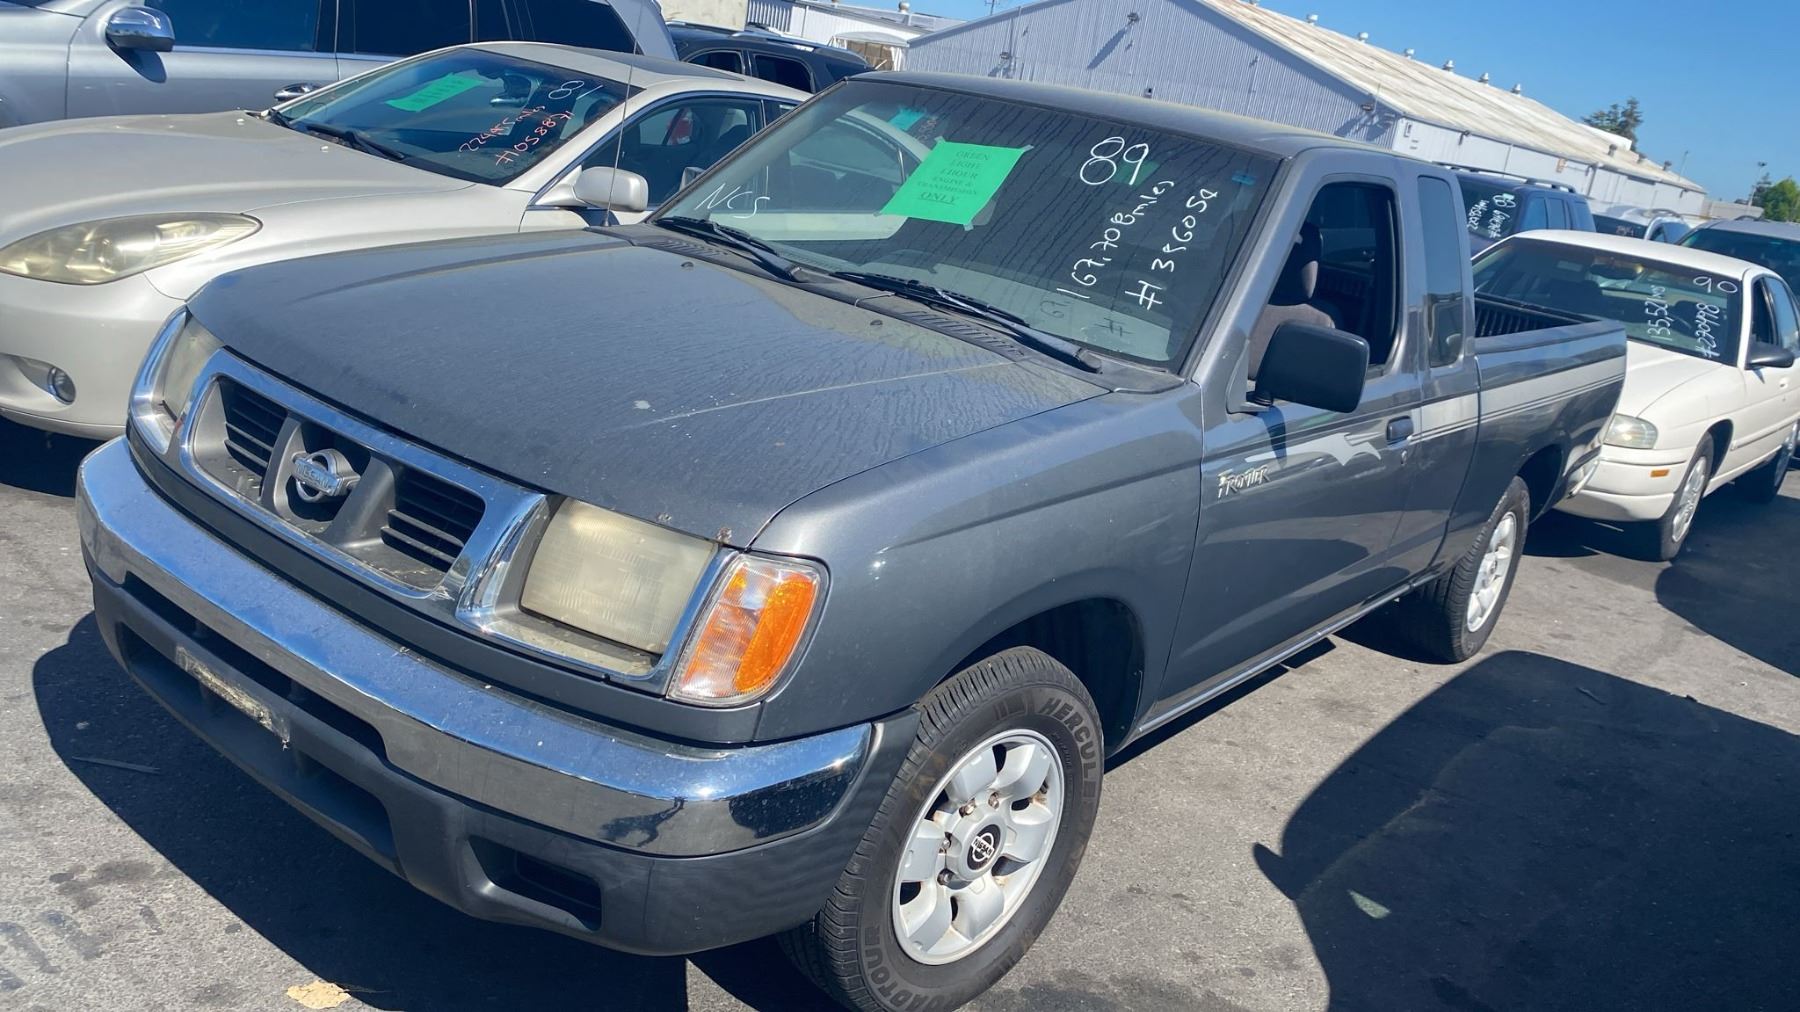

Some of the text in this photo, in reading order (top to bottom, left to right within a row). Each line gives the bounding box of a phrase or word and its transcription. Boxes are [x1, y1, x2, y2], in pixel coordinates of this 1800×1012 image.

[1080, 136, 1149, 186] 89
[920, 191, 958, 204] ONLY
[1693, 276, 1738, 294] 90
[296, 460, 337, 489] NISSAN
